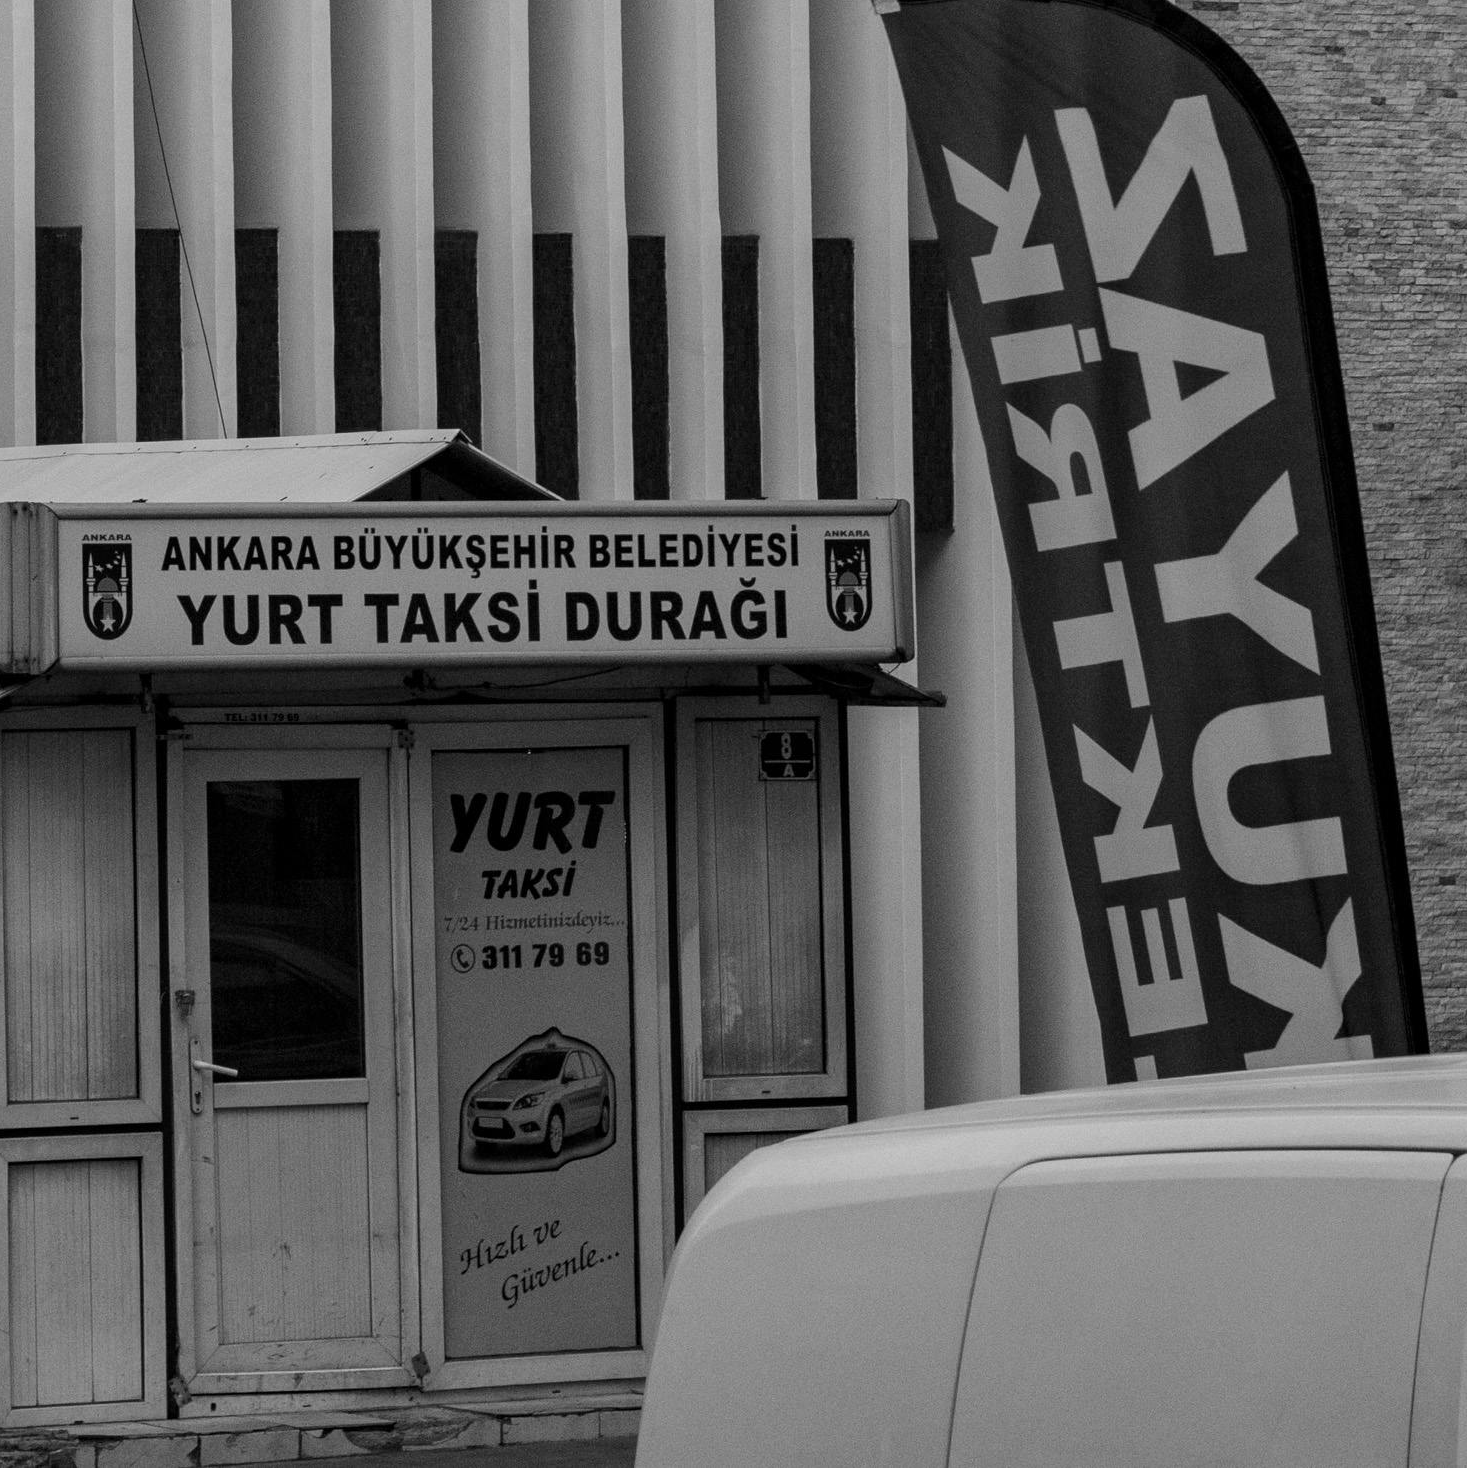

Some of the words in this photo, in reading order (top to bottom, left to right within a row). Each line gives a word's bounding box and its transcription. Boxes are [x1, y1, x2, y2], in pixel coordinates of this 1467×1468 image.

[82, 533, 132, 542] ANKARA
[824, 529, 871, 538] ANKARA
[162, 535, 320, 571] ANKARA
[333, 525, 576, 579] BÜYÜKŞEHİR
[590, 524, 799, 568] BELEDİYESİ
[177, 593, 343, 646] YURT
[364, 579, 541, 644] TAKSİ
[566, 576, 787, 642] DURAĞI
[224, 713, 247, 722] TEL:
[250, 713, 268, 722] 311
[272, 713, 284, 722] 79
[781, 733, 792, 760] 8
[783, 763, 795, 777] A
[450, 791, 616, 854] YURT
[482, 860, 577, 900] TAKSİ
[444, 916, 479, 933] 7/24
[482, 945, 522, 970] 311
[532, 943, 564, 968] 79
[576, 941, 610, 966] 69
[460, 1225, 528, 1275] Hızlı
[533, 1219, 562, 1245] ve
[501, 1241, 620, 1309] Güvenle...
